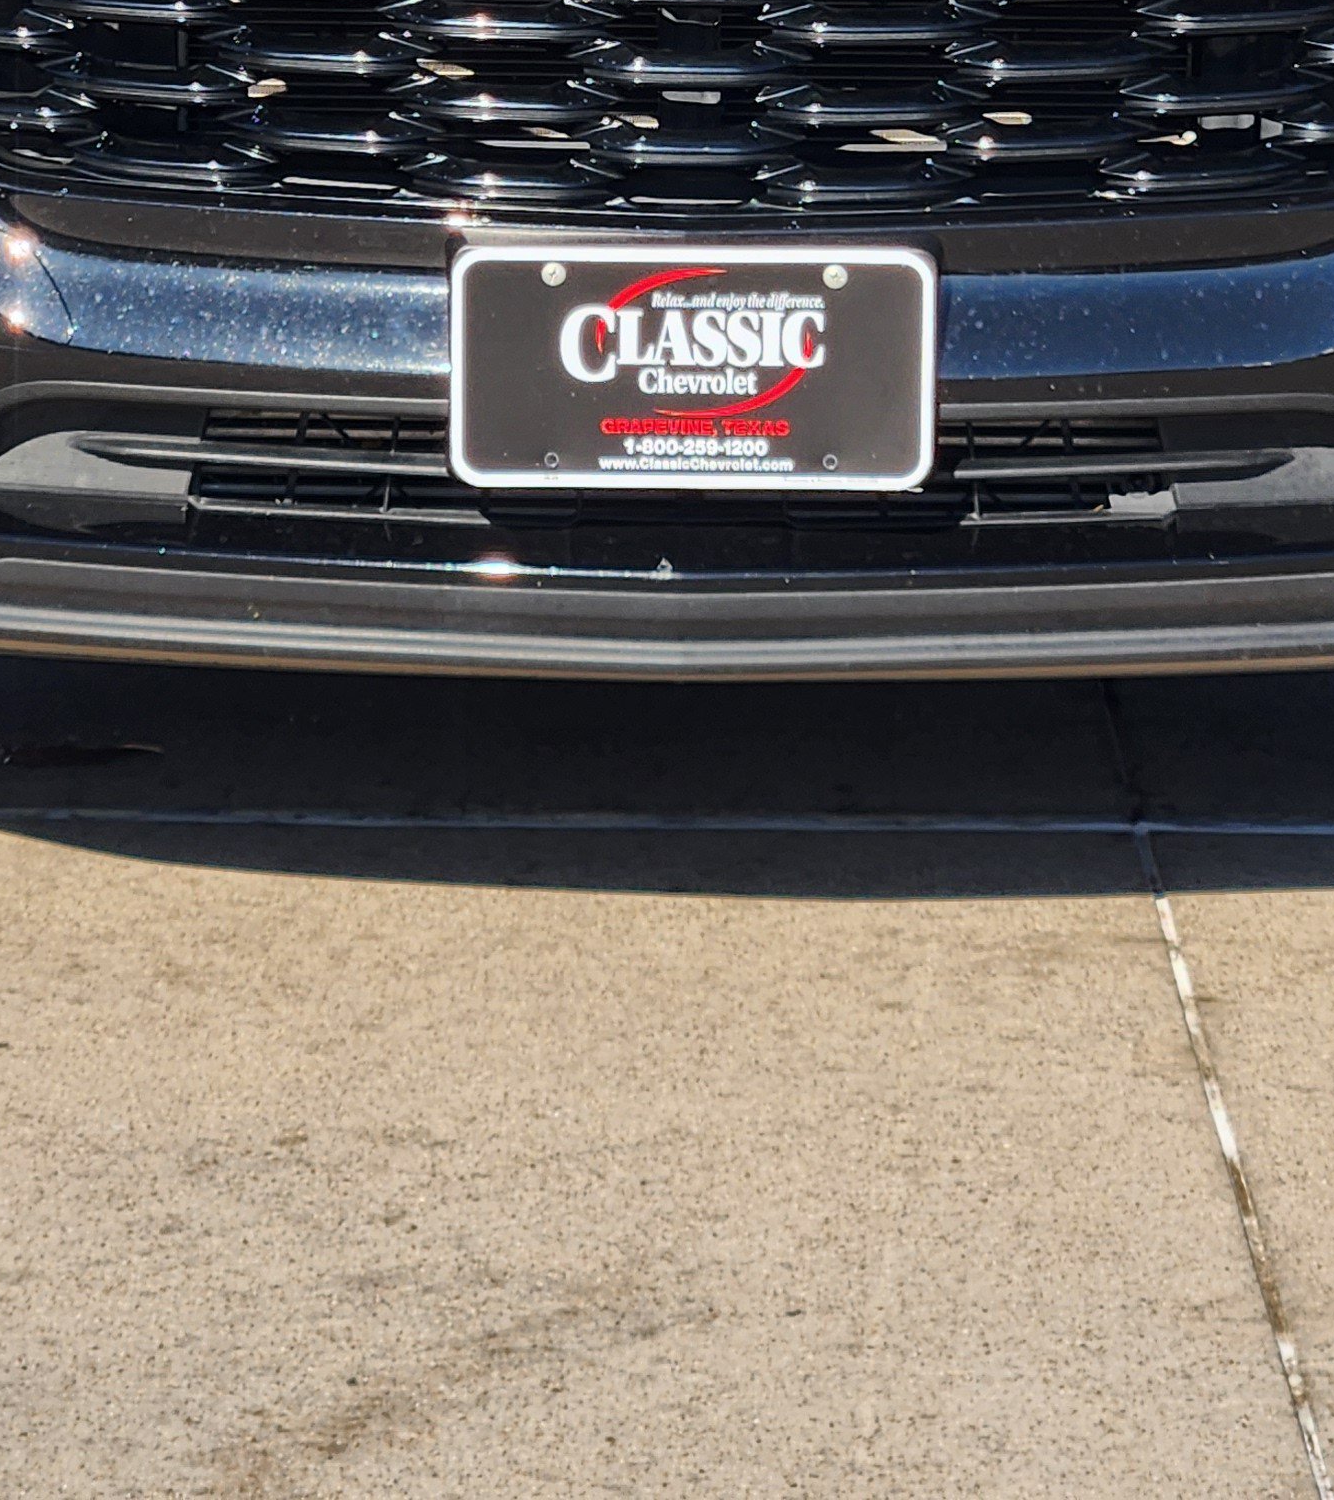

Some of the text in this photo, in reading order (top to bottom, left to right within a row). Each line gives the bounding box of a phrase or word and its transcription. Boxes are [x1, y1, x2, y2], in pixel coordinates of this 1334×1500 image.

[717, 292, 747, 311] enjoy
[748, 292, 767, 308] the
[560, 305, 827, 383] CLASSIC
[638, 367, 758, 395] Chevrolet
[600, 418, 791, 437] GRAPEVINE, TEXAS
[623, 436, 769, 457] 1-800-259-1200
[598, 456, 795, 472] www.ClassicChevrolet.com
